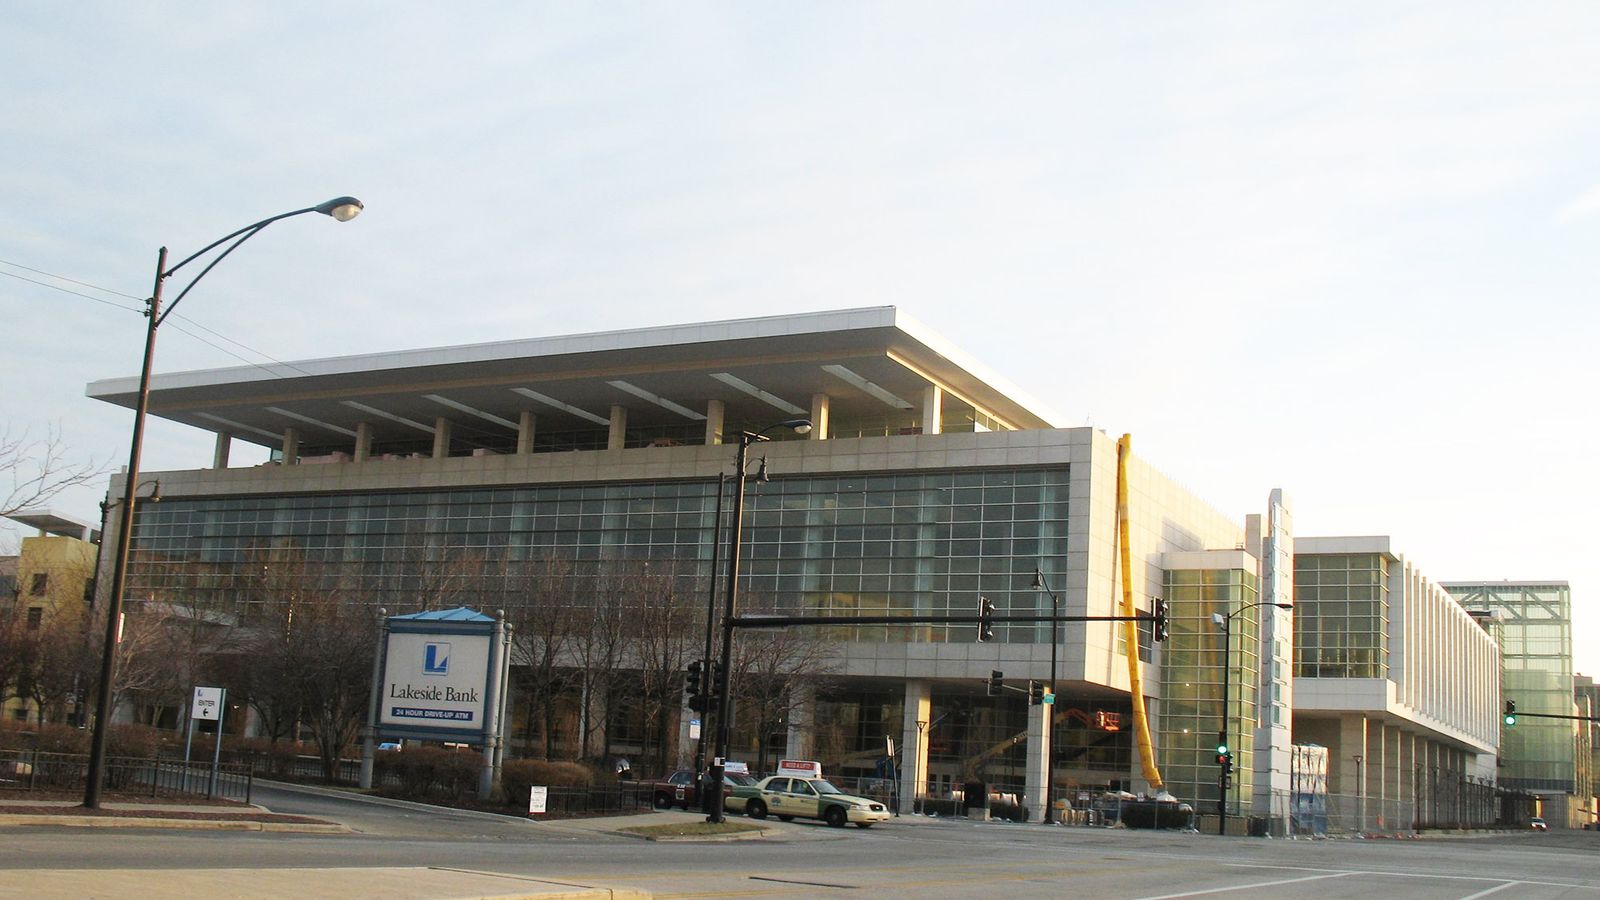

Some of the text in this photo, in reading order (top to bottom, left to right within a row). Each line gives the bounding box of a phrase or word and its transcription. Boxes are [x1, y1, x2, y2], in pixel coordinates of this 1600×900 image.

[390, 684, 479, 702] Lakeside Bank
[405, 709, 424, 717] HOUR
[424, 710, 454, 718] DRIVE-UP
